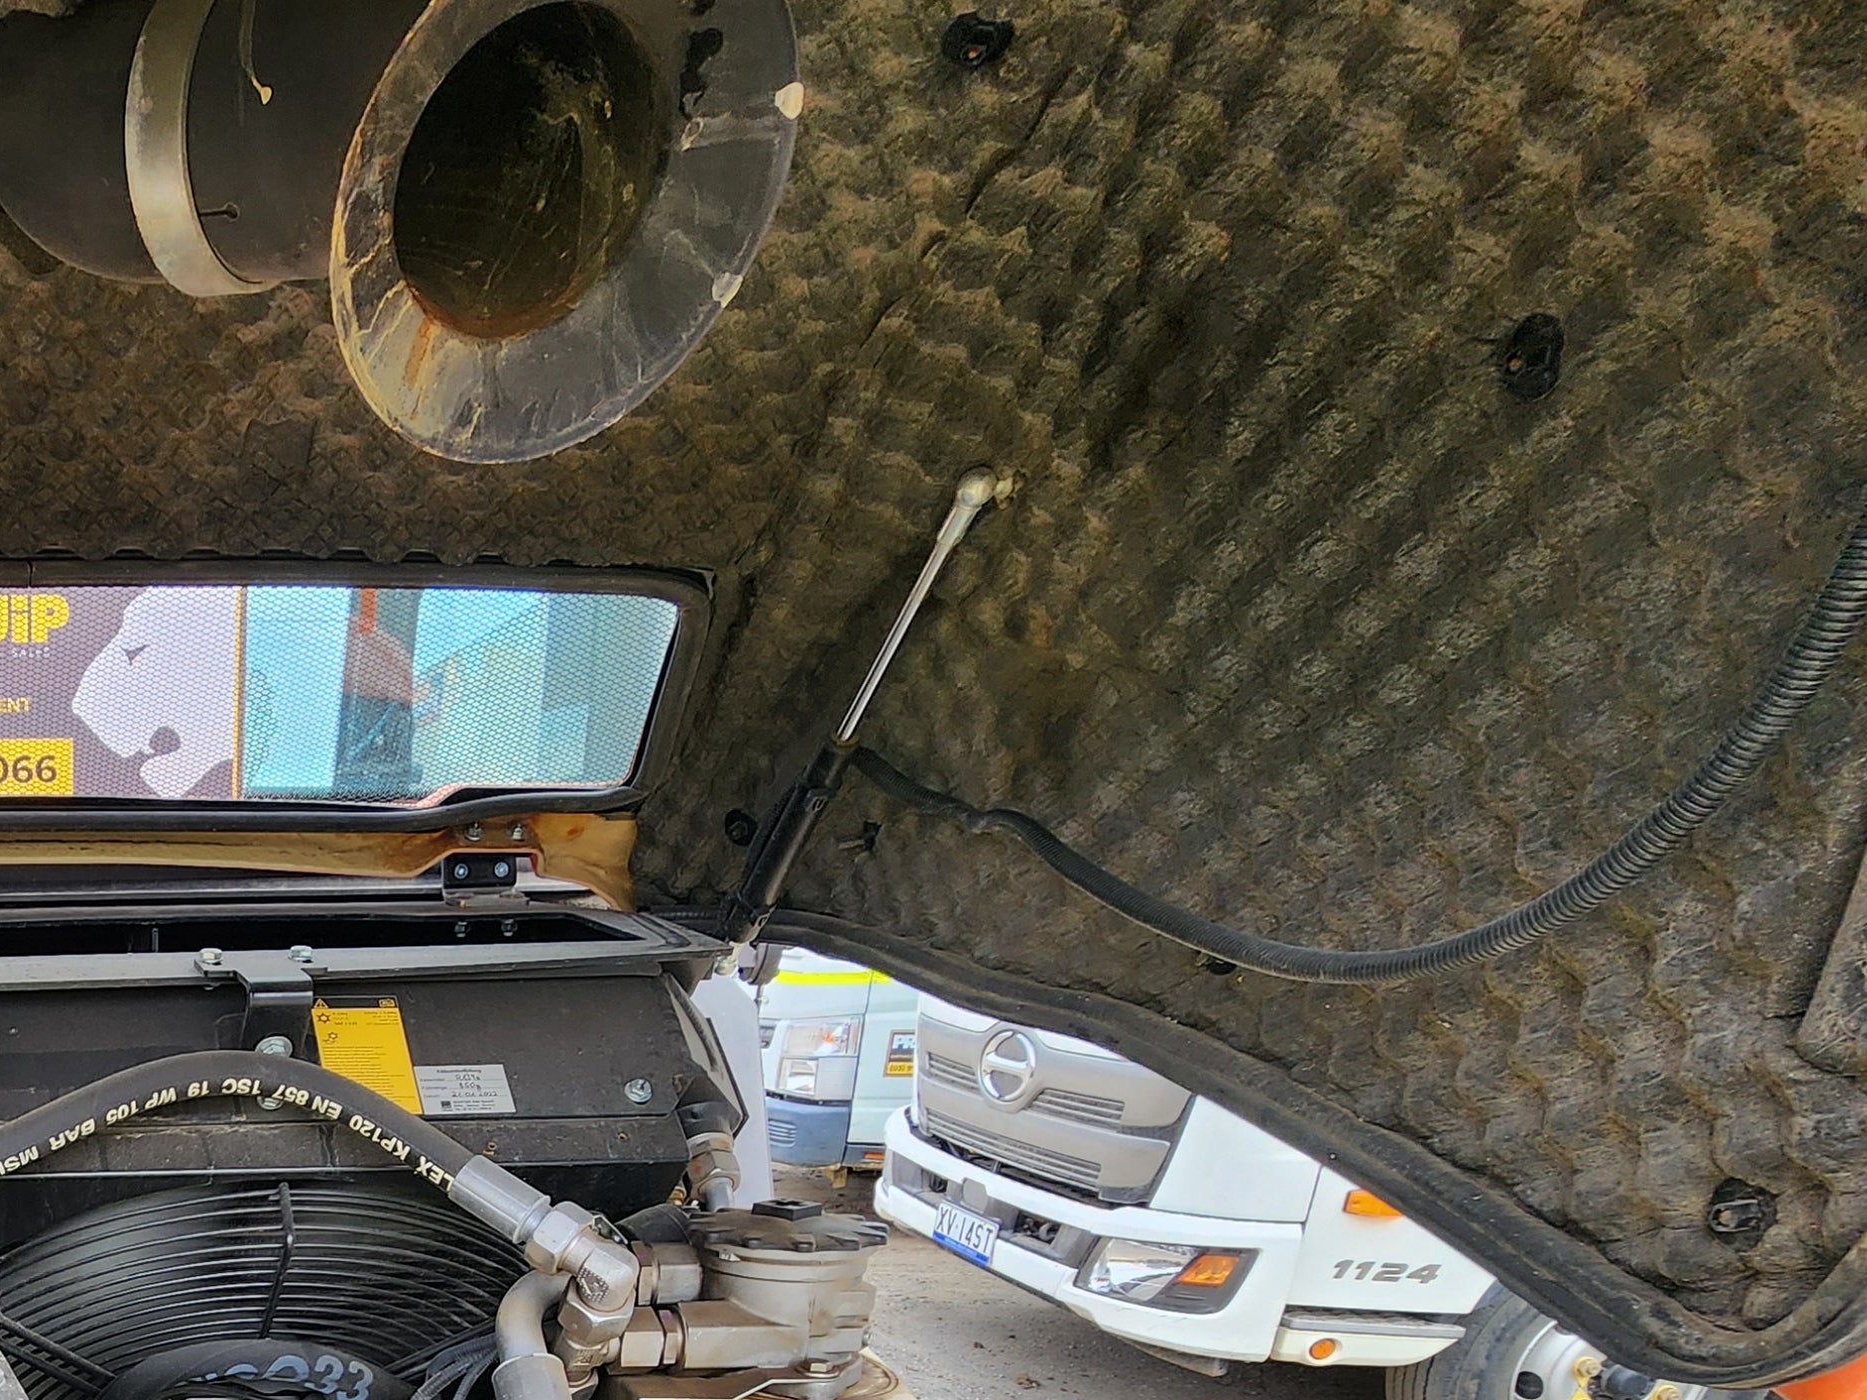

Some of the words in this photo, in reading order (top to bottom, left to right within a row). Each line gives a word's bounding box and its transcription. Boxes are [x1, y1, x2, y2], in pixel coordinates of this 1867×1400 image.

[187, 1080, 210, 1098] 19
[221, 1078, 261, 1095] 1SC
[272, 1084, 310, 1106] 857
[145, 1087, 177, 1110] WP
[311, 1098, 343, 1120] EN
[105, 1100, 139, 1125] 105
[49, 1118, 96, 1151] BAR
[348, 1114, 411, 1161] KP120
[1332, 1259, 1442, 1284] 1124
